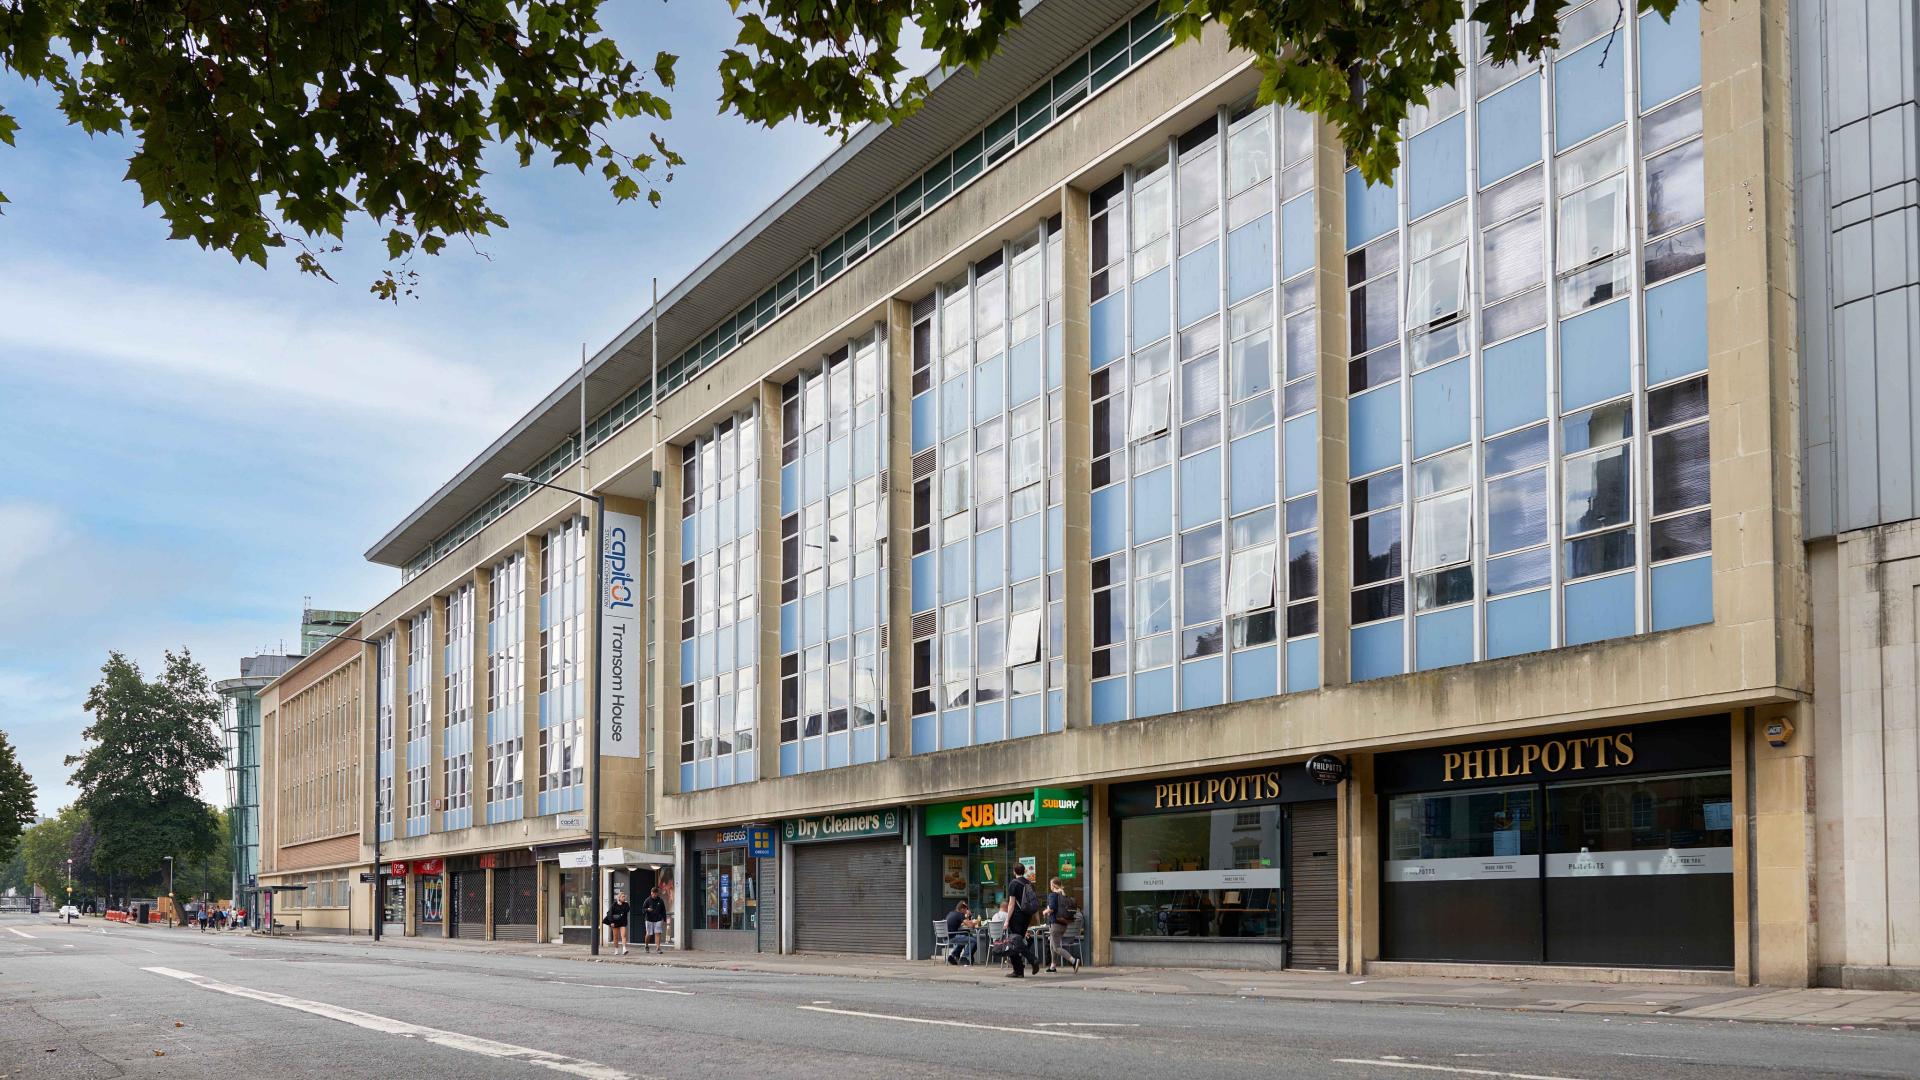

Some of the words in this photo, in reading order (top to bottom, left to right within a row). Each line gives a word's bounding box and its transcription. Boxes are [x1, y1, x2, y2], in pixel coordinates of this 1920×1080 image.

[605, 527, 634, 609] capitol
[612, 623, 625, 691] Transom
[611, 695, 625, 742] House
[1442, 732, 1634, 782] PHILPOTTS
[1041, 798, 1079, 810] SUBWAY
[1155, 771, 1279, 809] PHILPOTTS
[798, 818, 820, 839] Dry
[822, 814, 880, 834] Cleaners
[958, 799, 1036, 830] SUBWAY
[722, 830, 746, 842] GREGGS
[980, 836, 998, 848] Open
